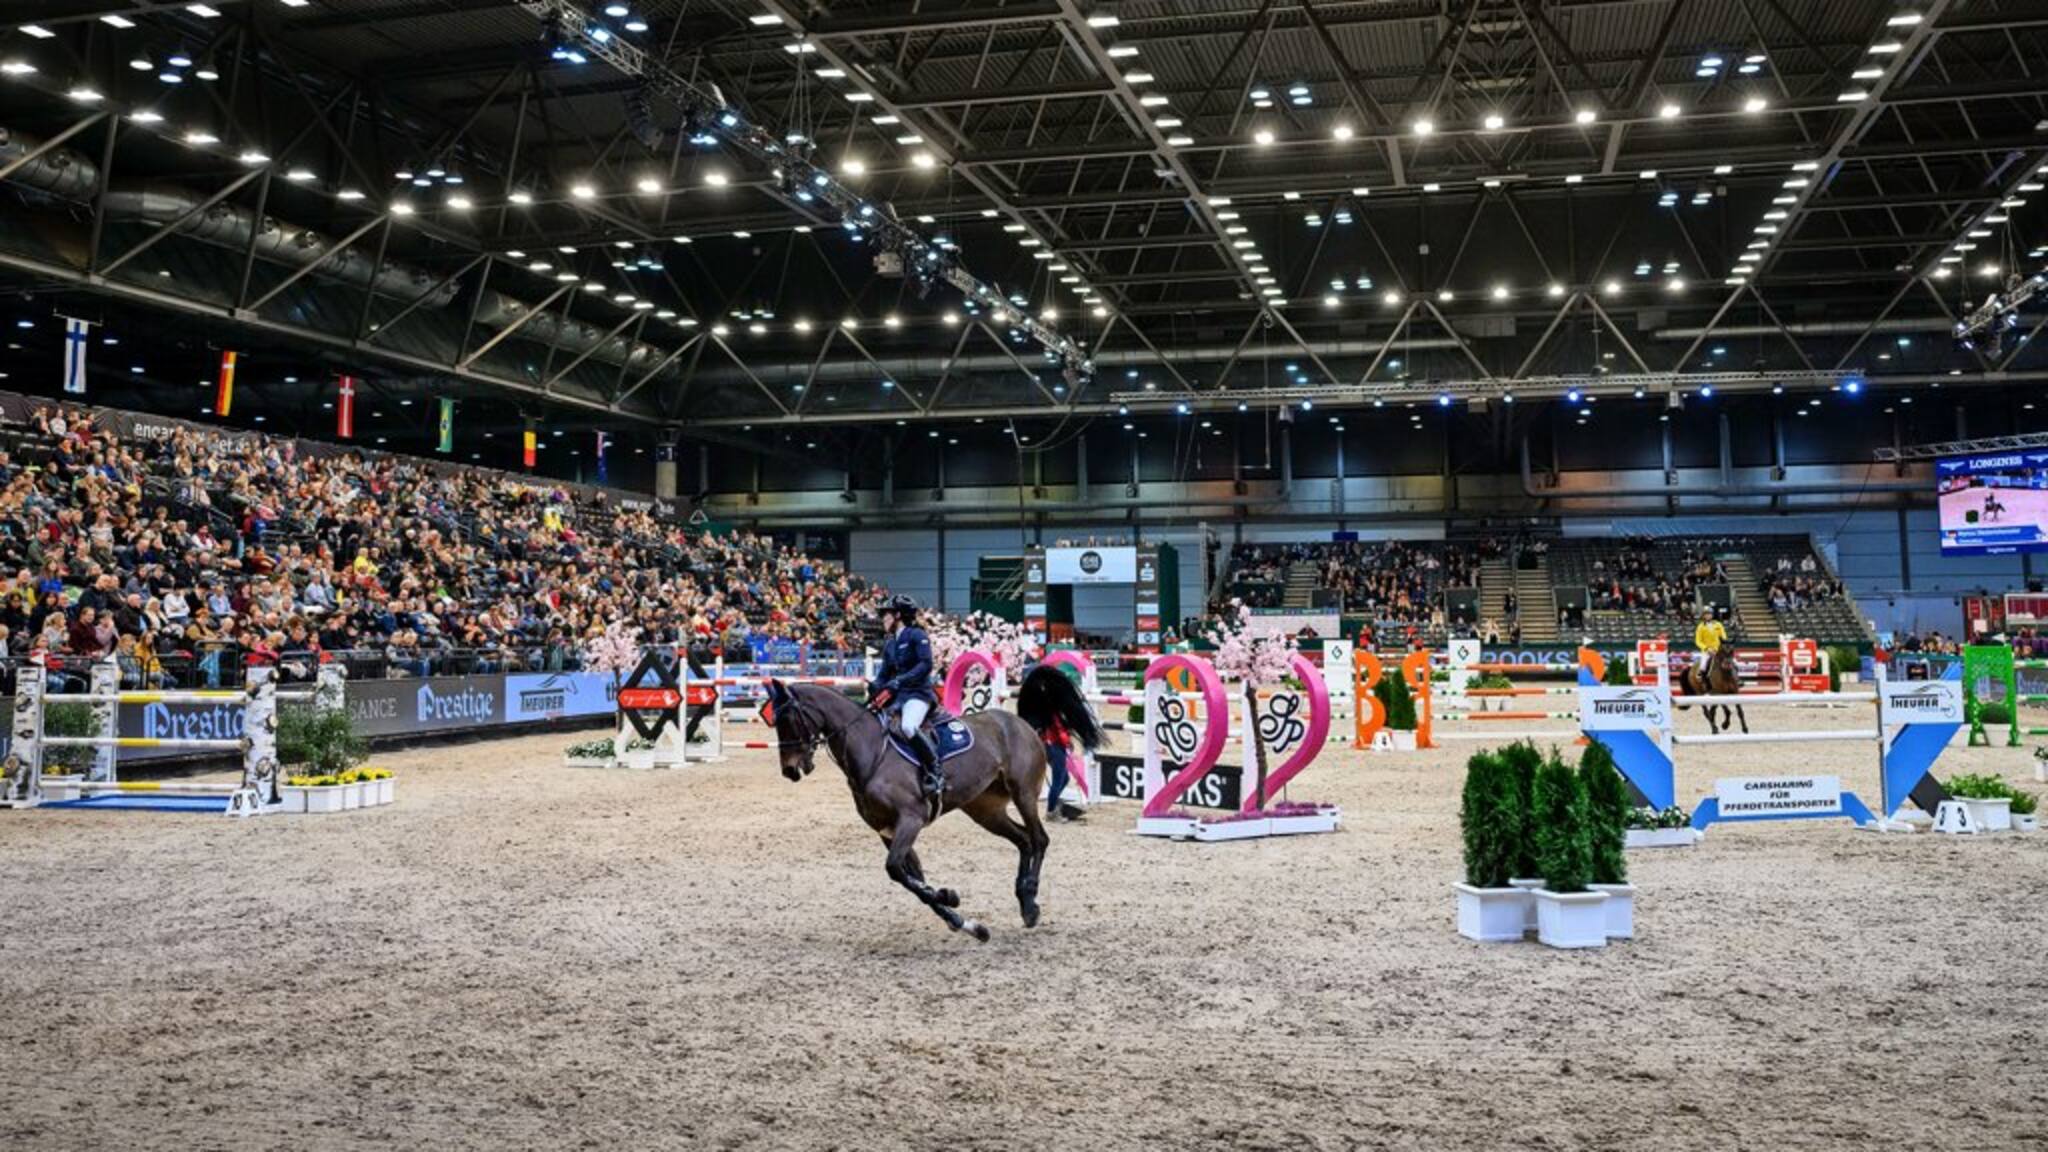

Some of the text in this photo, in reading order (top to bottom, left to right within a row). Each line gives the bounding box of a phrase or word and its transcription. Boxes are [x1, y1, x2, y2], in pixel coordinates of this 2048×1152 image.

[1969, 456, 2023, 470] LONGINES
[417, 682, 495, 723] Prestige
[1593, 699, 1646, 714] THEURER
[1889, 694, 1939, 708] THEURER
[349, 698, 398, 721] SANCE
[1744, 779, 1813, 791] CARSHARING
[1769, 790, 1791, 799] FÜR
[1723, 799, 1837, 811] PFERDETRANSPORTER
